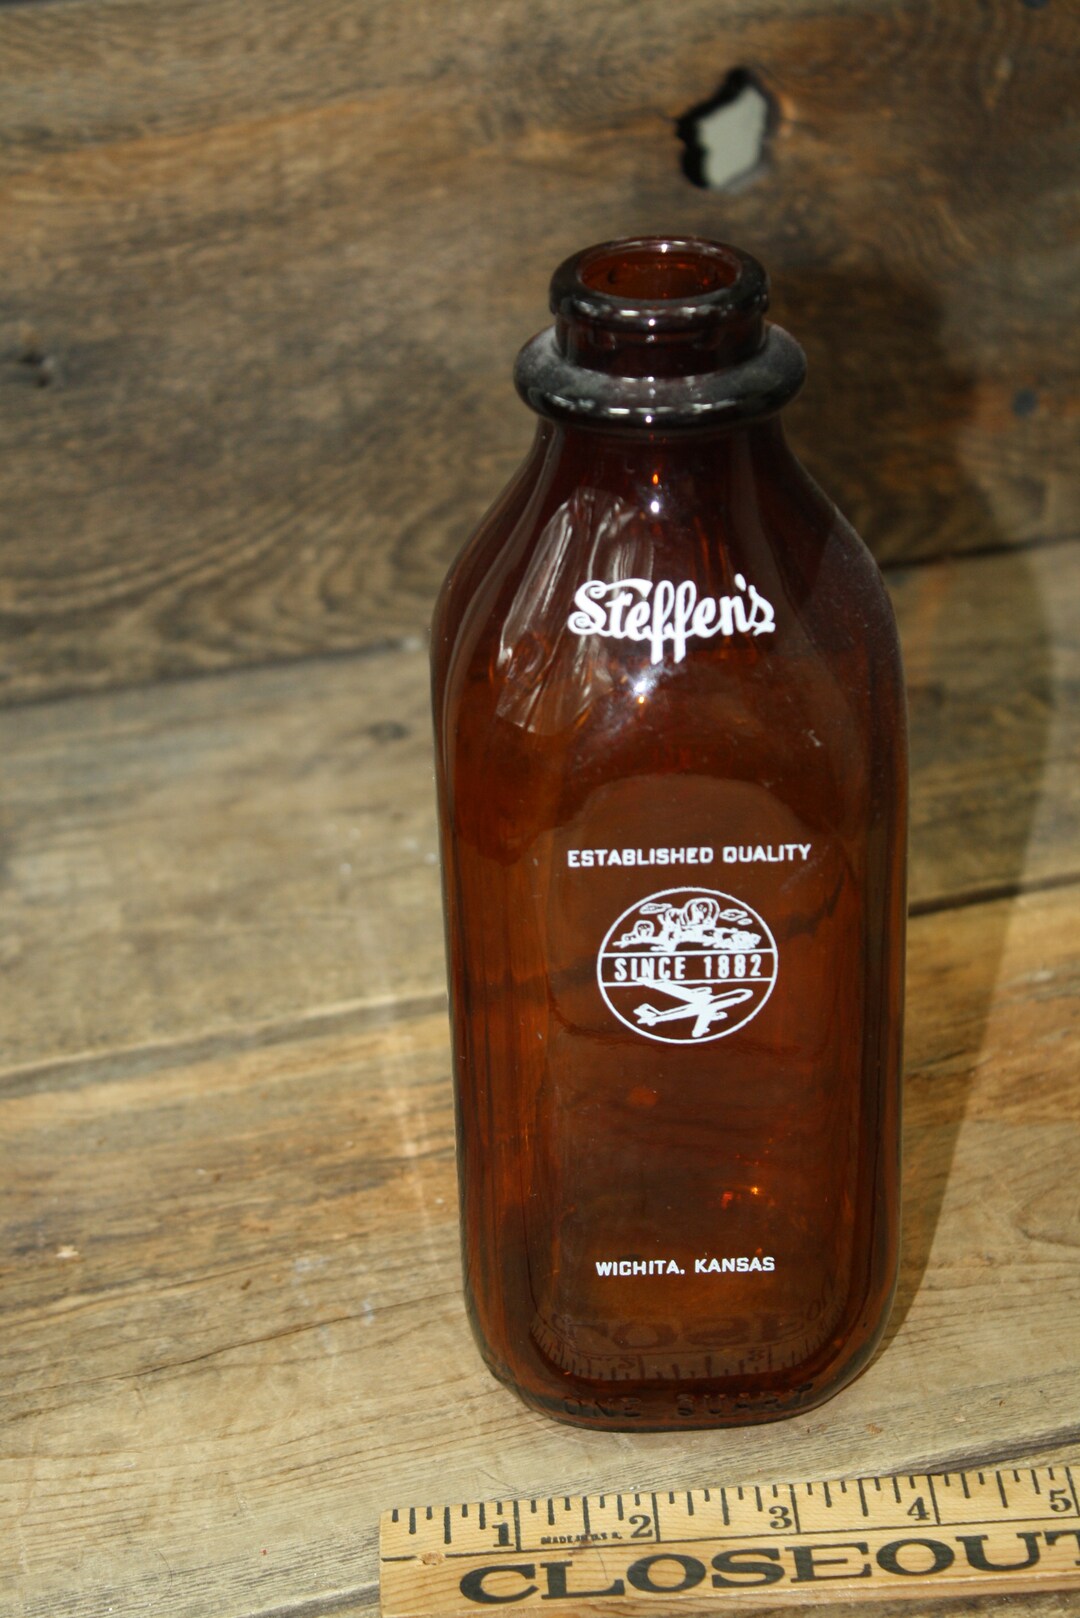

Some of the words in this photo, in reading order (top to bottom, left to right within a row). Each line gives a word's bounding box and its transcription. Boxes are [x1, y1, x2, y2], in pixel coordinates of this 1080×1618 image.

[567, 573, 776, 665] Steffen's
[567, 847, 714, 867] ESTABLISHED
[722, 844, 811, 863] QUALITY
[614, 957, 686, 982] SINCE
[703, 954, 762, 977] 1882
[694, 1256, 775, 1273] KANSAS
[492, 1522, 514, 1547] 1
[629, 1514, 653, 1538] 2
[769, 1506, 793, 1529] 3
[907, 1497, 930, 1521] 4
[1049, 1489, 1073, 1512] 5
[541, 1535, 573, 1545] MADE
